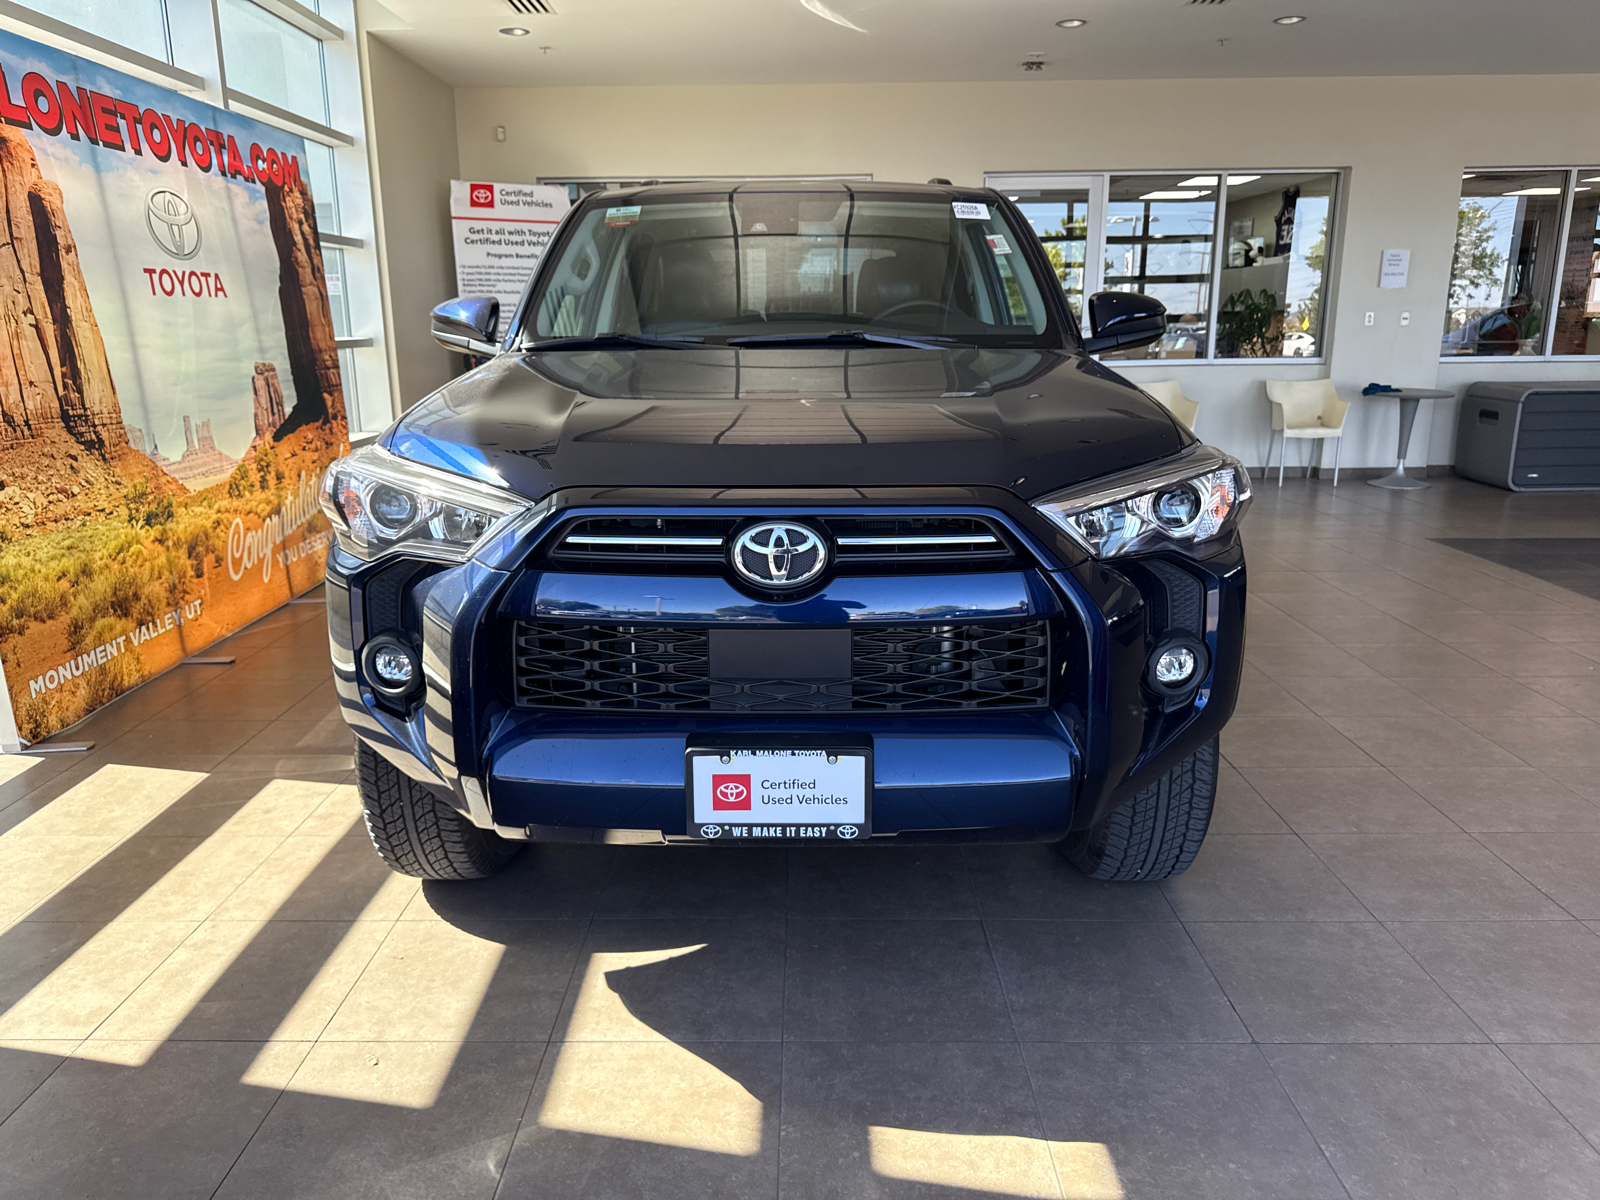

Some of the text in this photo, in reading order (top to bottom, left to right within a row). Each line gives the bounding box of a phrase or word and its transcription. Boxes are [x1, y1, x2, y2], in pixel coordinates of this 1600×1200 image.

[500, 189, 534, 198] Certified
[500, 198, 553, 208] Used Vehicles
[468, 226, 485, 235] Get
[486, 227, 493, 235] it
[494, 227, 506, 235] all
[507, 228, 526, 236] with
[464, 237, 502, 246] Certified
[503, 238, 525, 246] Used
[486, 252, 514, 260] Program
[143, 267, 228, 298] TOYOTA
[276, 528, 334, 568] YOU DESERV
[28, 599, 202, 698] MONUMENT VALLEY, UT
[761, 779, 816, 790] Certified
[761, 794, 848, 805] Used Vehicles
[732, 826, 827, 837] WE MAKE IT EASY
